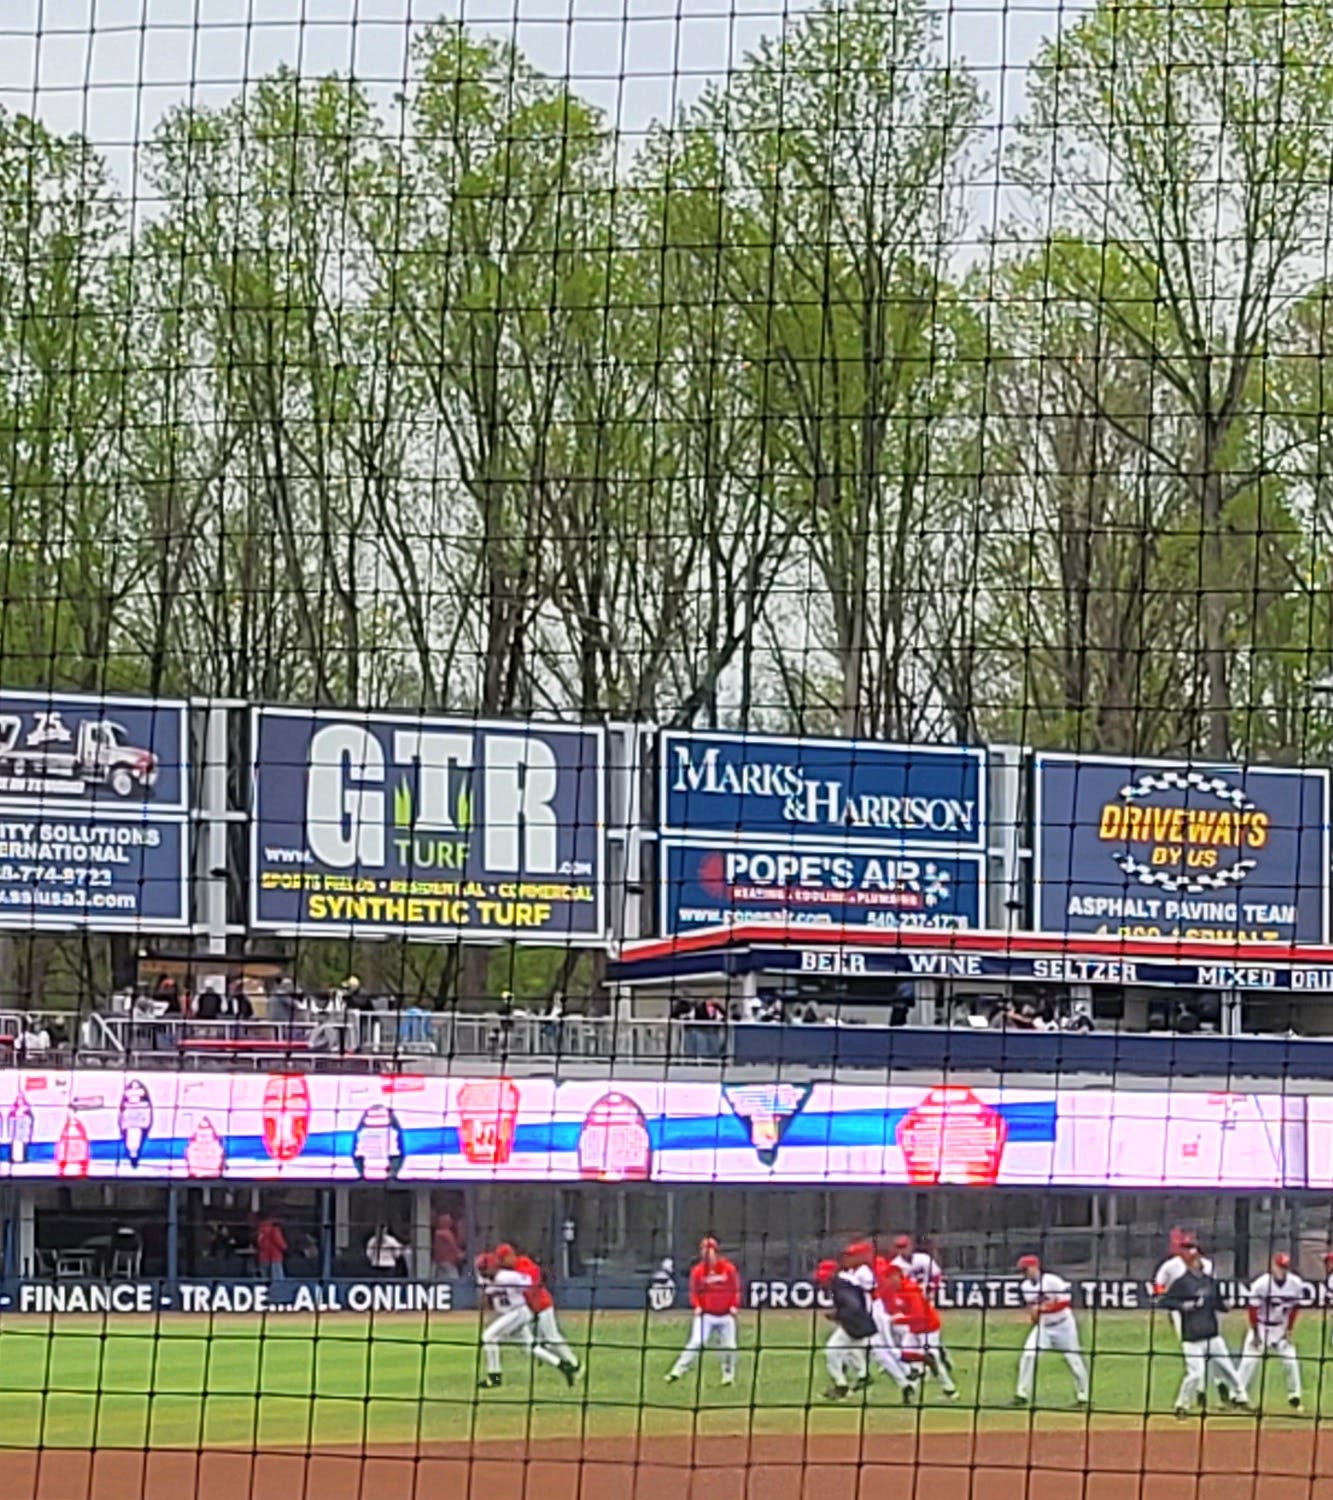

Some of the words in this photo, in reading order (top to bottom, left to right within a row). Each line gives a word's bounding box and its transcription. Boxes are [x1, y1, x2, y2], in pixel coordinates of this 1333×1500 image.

[673, 746, 803, 795] MARKS
[307, 724, 557, 873] GTR
[40, 825, 160, 846] SOLUTIONS
[1099, 804, 1269, 848] DRIVEWAYS
[394, 838, 472, 869] TURF
[1151, 847, 1183, 865] BY
[1187, 850, 1218, 868] US
[726, 853, 854, 889] POPE'S
[863, 859, 921, 891] AIR
[308, 893, 470, 925] SYNTHETIC
[476, 900, 552, 926] TURF
[1068, 895, 1162, 919] ASPHALT
[1164, 899, 1238, 921] PAVING
[800, 951, 867, 972] BEER
[909, 954, 984, 975] WINE
[1033, 959, 1137, 982] SELTZER
[1197, 965, 1276, 988] MIXED
[20, 1285, 152, 1312] FINANCE
[349, 1284, 452, 1311] ONLINE
[750, 1281, 834, 1308] PROU
[1081, 1281, 1139, 1307] THE
